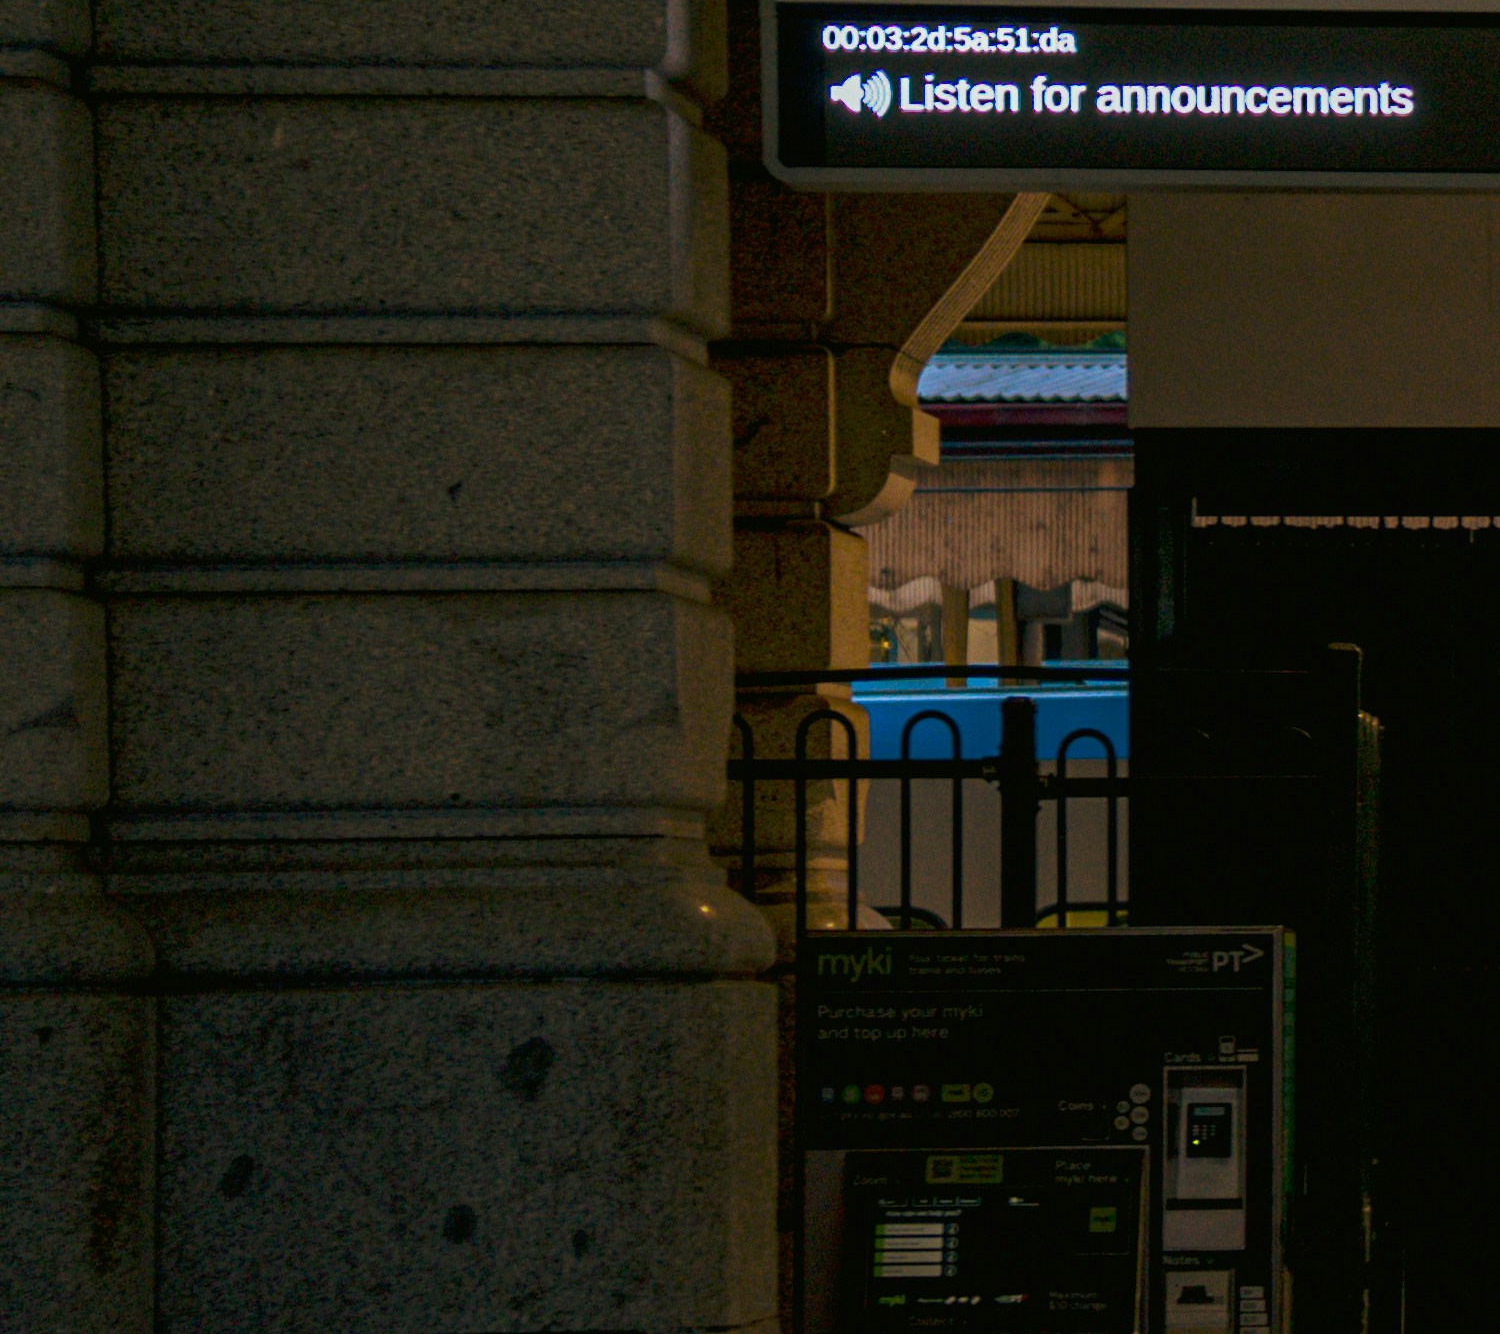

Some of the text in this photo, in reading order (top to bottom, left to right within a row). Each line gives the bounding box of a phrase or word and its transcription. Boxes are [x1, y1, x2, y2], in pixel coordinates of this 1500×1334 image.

[822, 26, 1076, 54] 00:03:2d:5a:51:da
[900, 75, 1414, 116] Listen for announcements
[818, 946, 892, 982] myki
[817, 1003, 938, 1022] Purchase your
[817, 1025, 950, 1042] and top here
